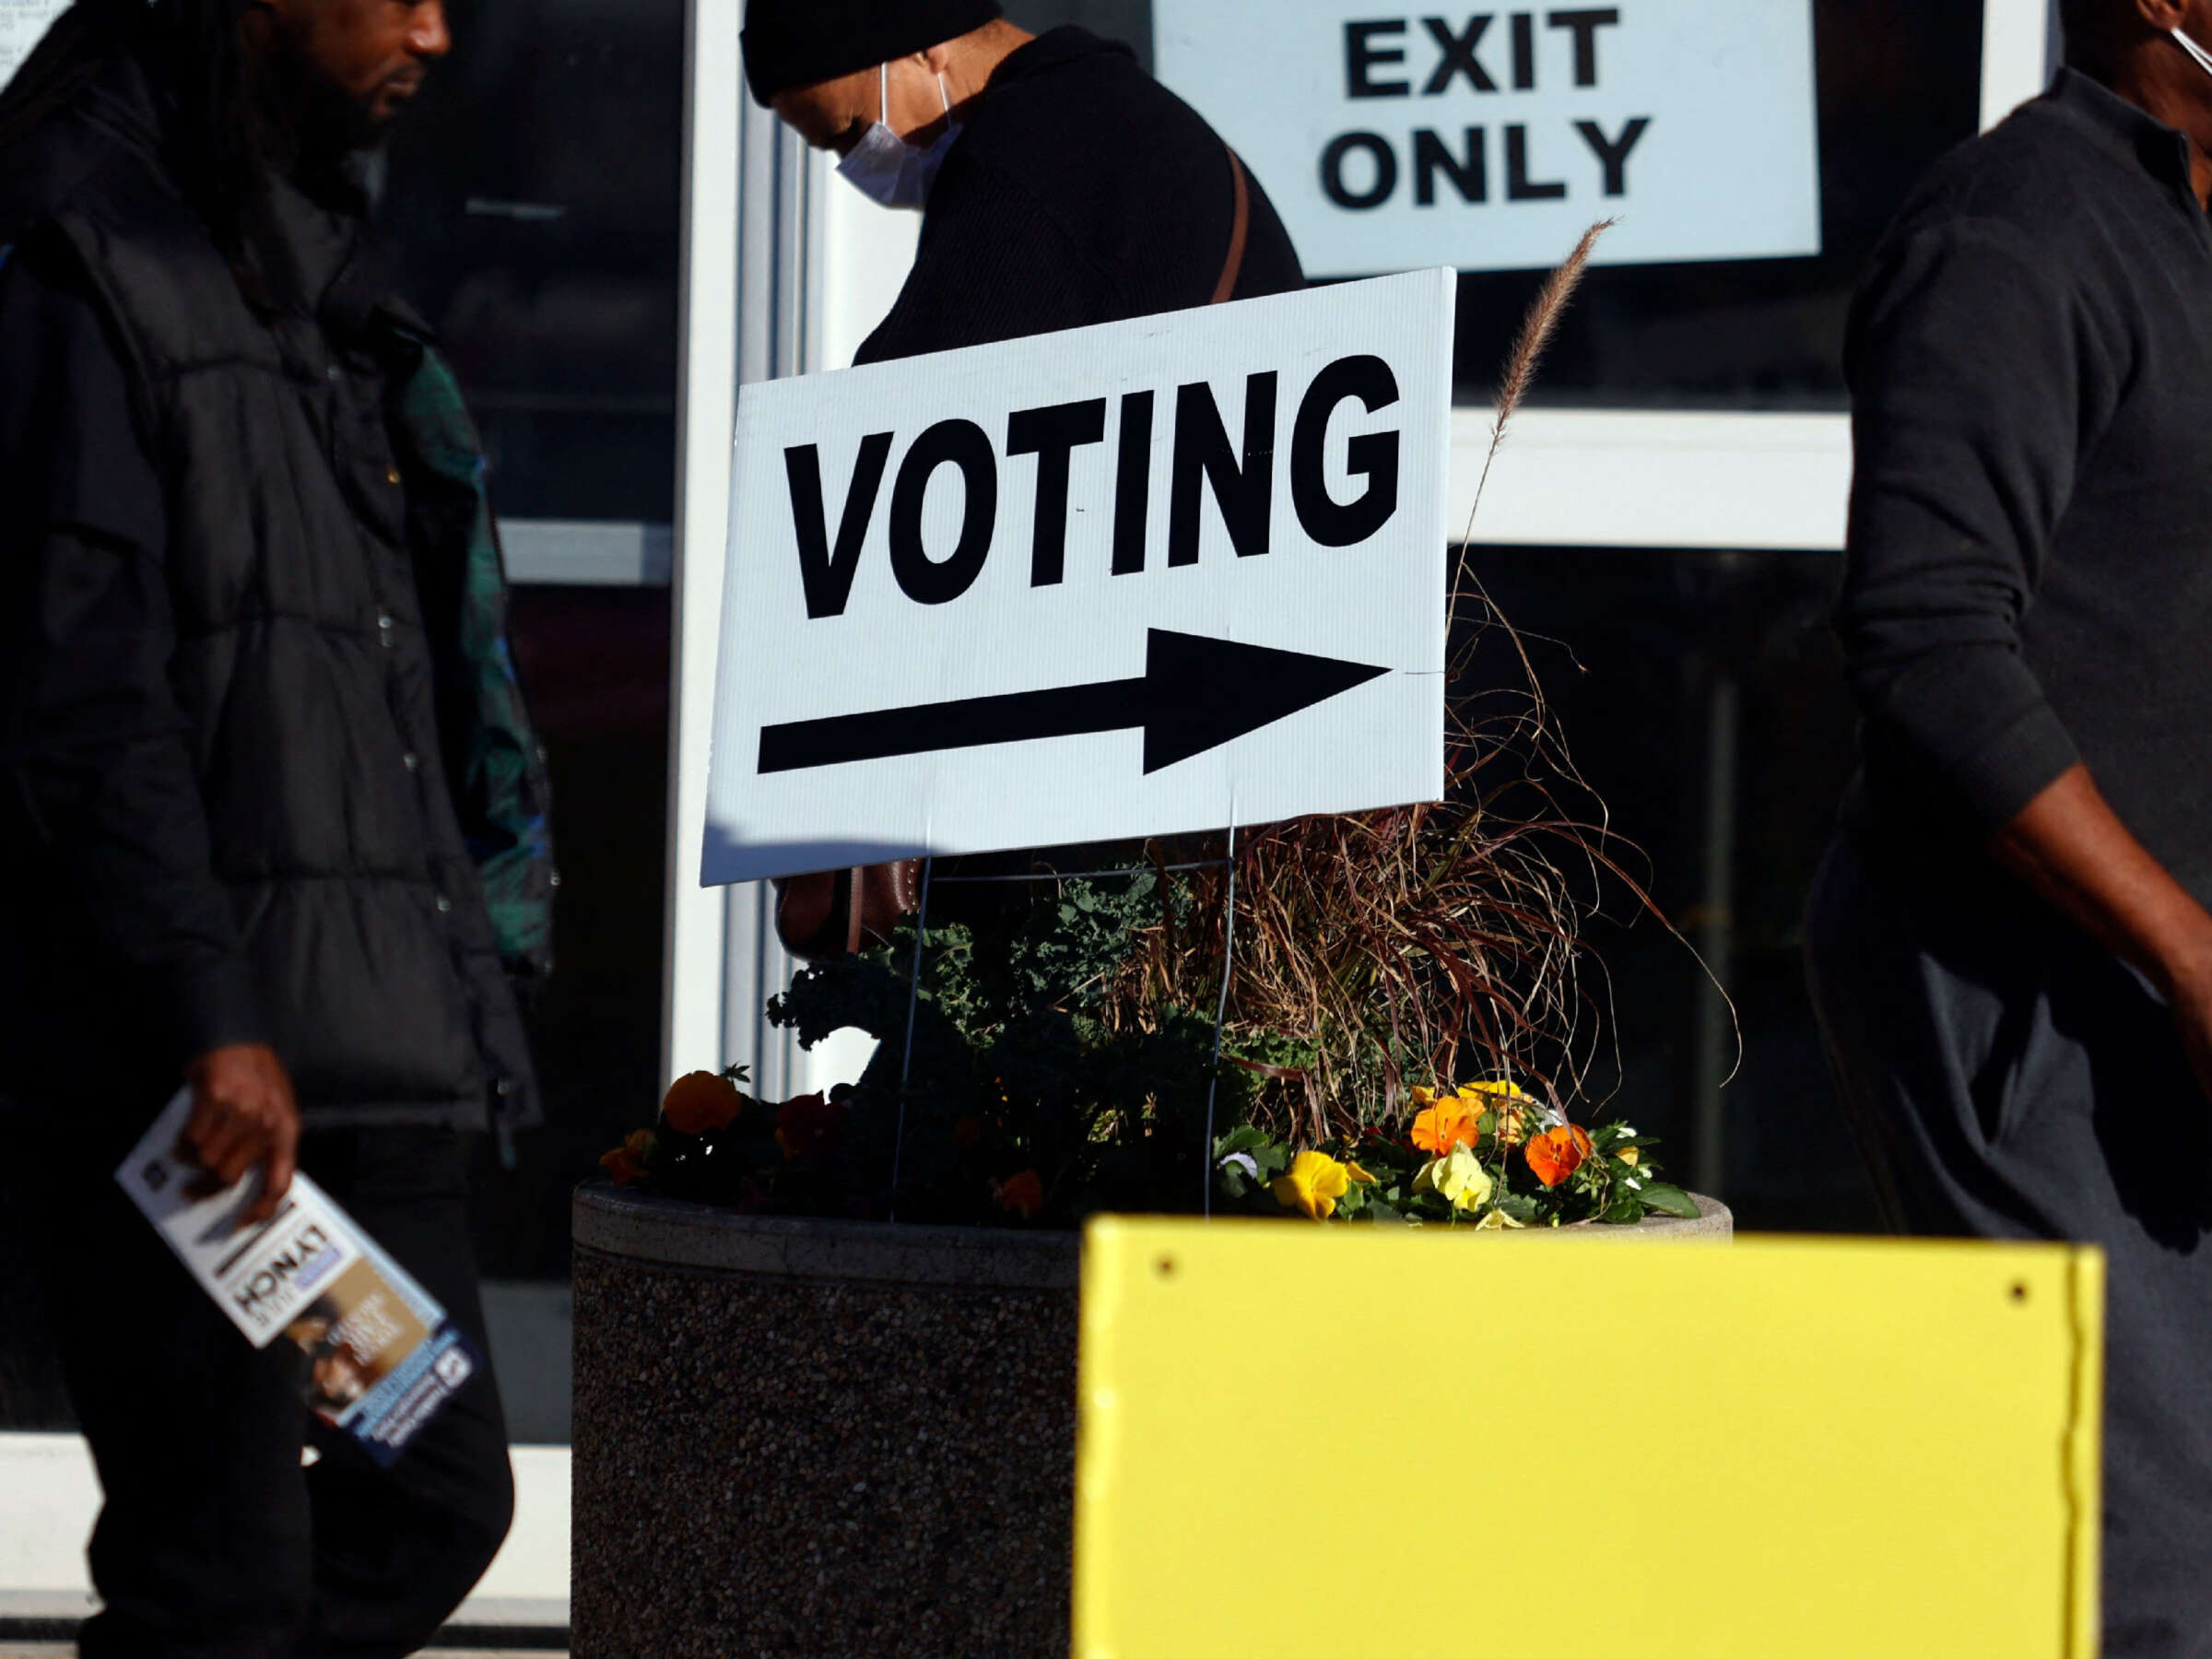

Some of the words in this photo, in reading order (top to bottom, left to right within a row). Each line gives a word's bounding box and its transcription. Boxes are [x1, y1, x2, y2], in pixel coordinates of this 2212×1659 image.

[1343, 7, 1621, 100] EXIT
[1318, 116, 1653, 210] ONLY
[783, 354, 1401, 619] VOTING
[232, 1224, 329, 1313] LYNCH
